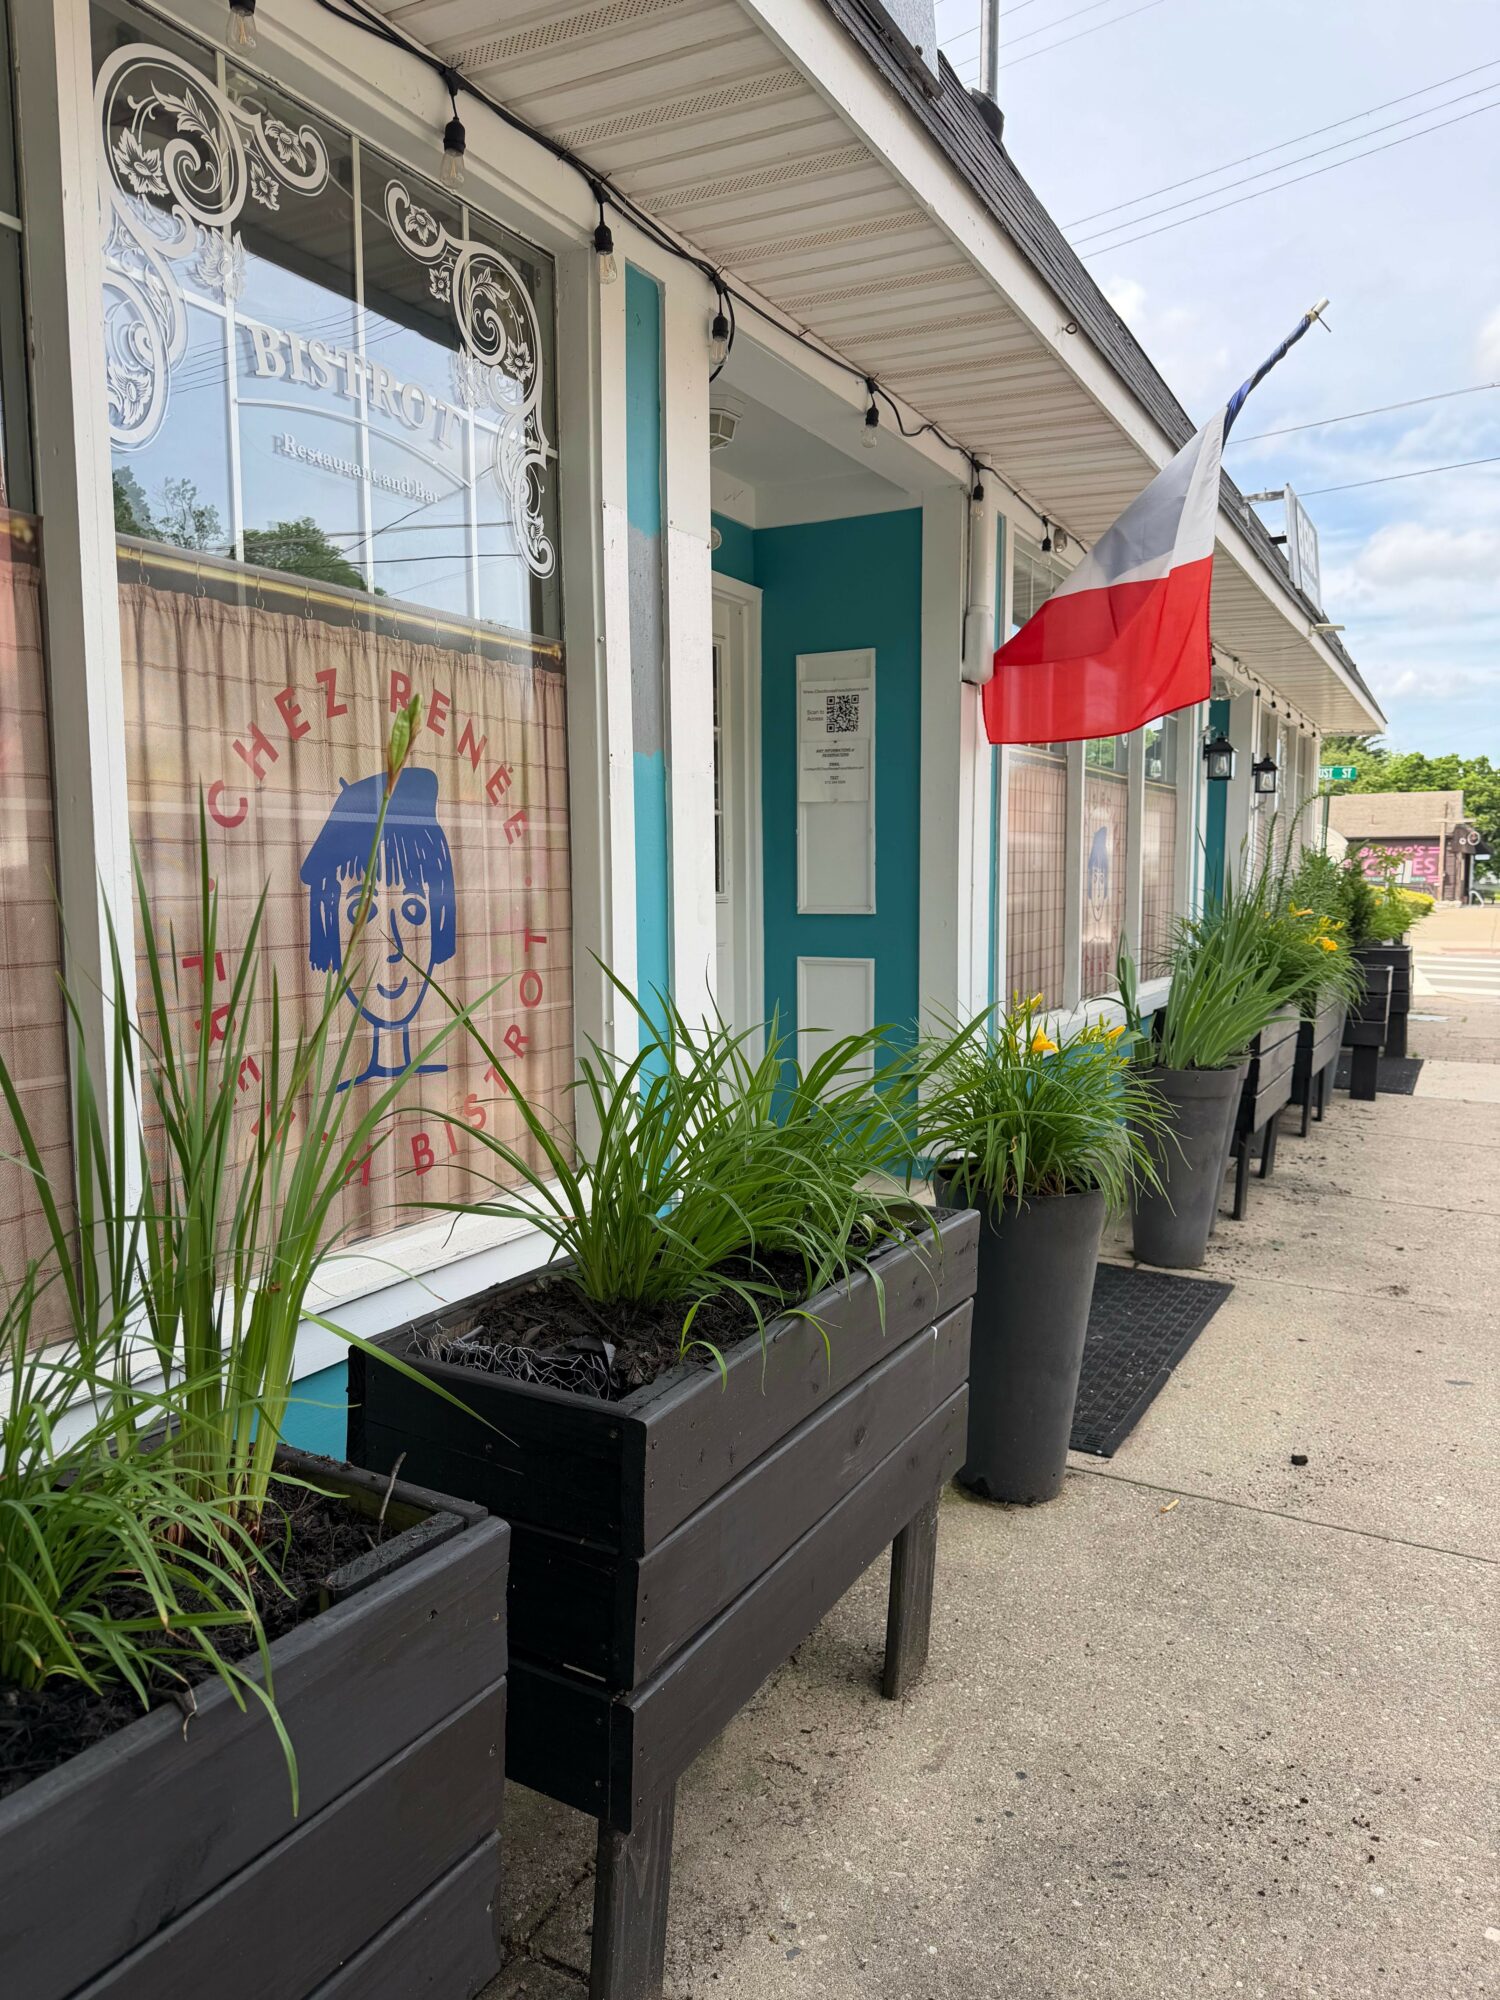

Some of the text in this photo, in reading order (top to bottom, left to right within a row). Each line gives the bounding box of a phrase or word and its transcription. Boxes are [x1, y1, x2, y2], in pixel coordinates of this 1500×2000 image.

[247, 324, 464, 449] BISTROT
[281, 431, 441, 504] Restaurant and Bar
[207, 667, 348, 829] CHEZ
[1319, 767, 1353, 778] UST ST
[1361, 858, 1436, 876] CES
[411, 926, 548, 1177] BISTROT
